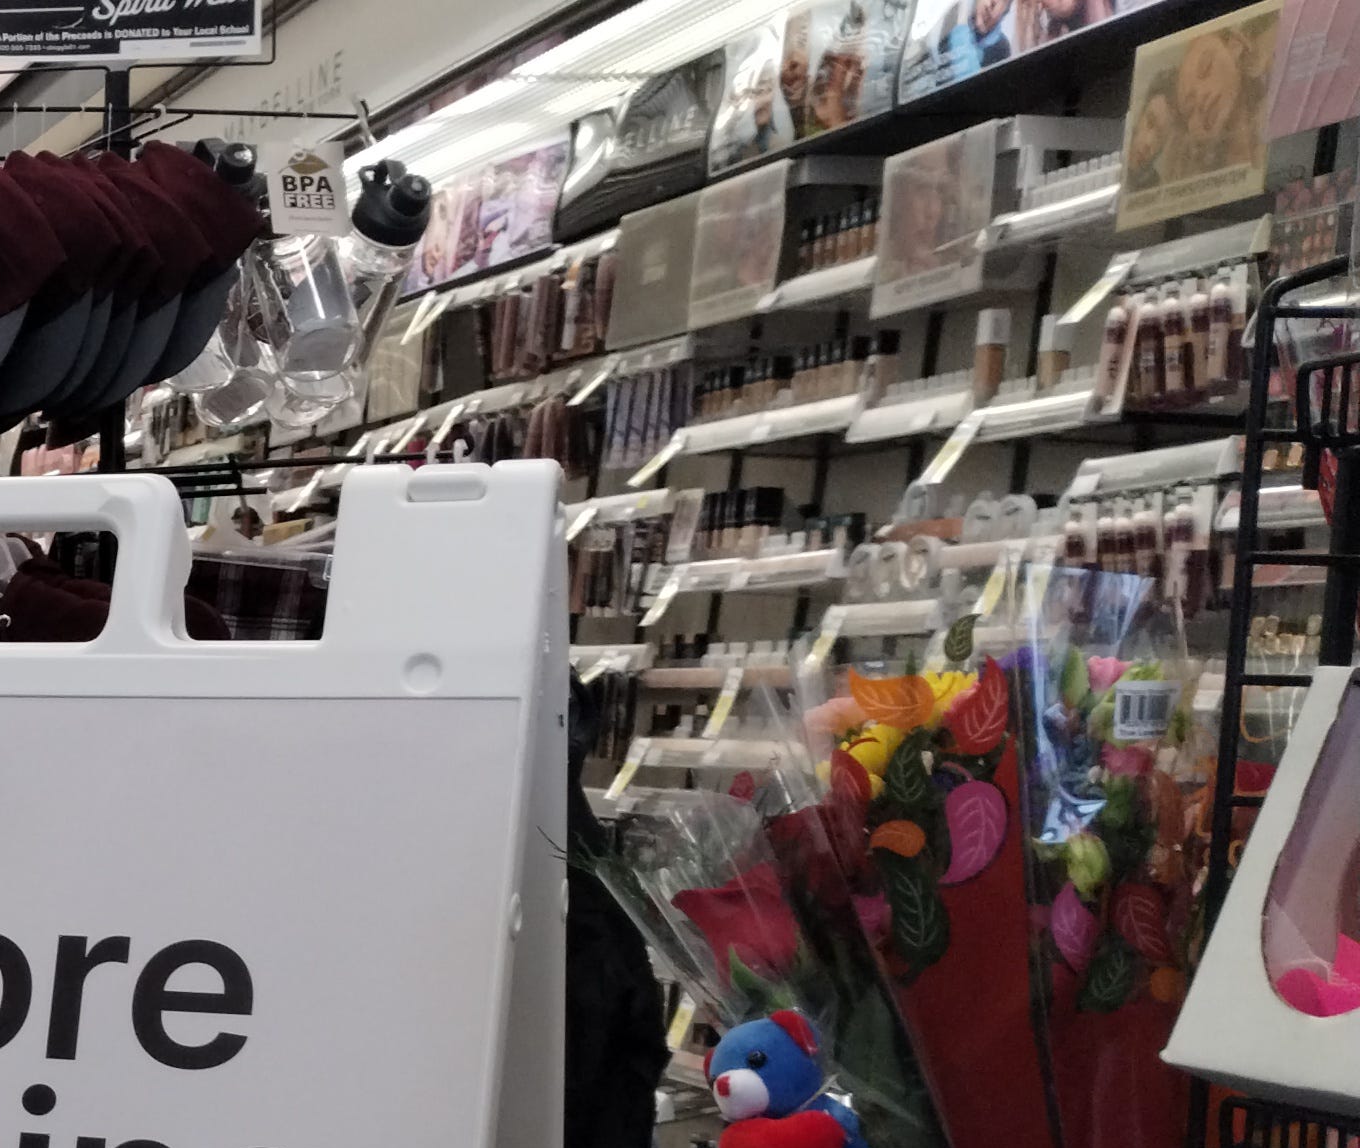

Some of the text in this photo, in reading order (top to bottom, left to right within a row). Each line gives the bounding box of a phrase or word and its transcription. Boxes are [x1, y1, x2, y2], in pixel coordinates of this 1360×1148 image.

[46, 31, 60, 40] the
[61, 30, 103, 40] Proceeds
[114, 28, 160, 38] DONATED
[282, 175, 333, 193] BPA
[284, 193, 335, 210] FREE
